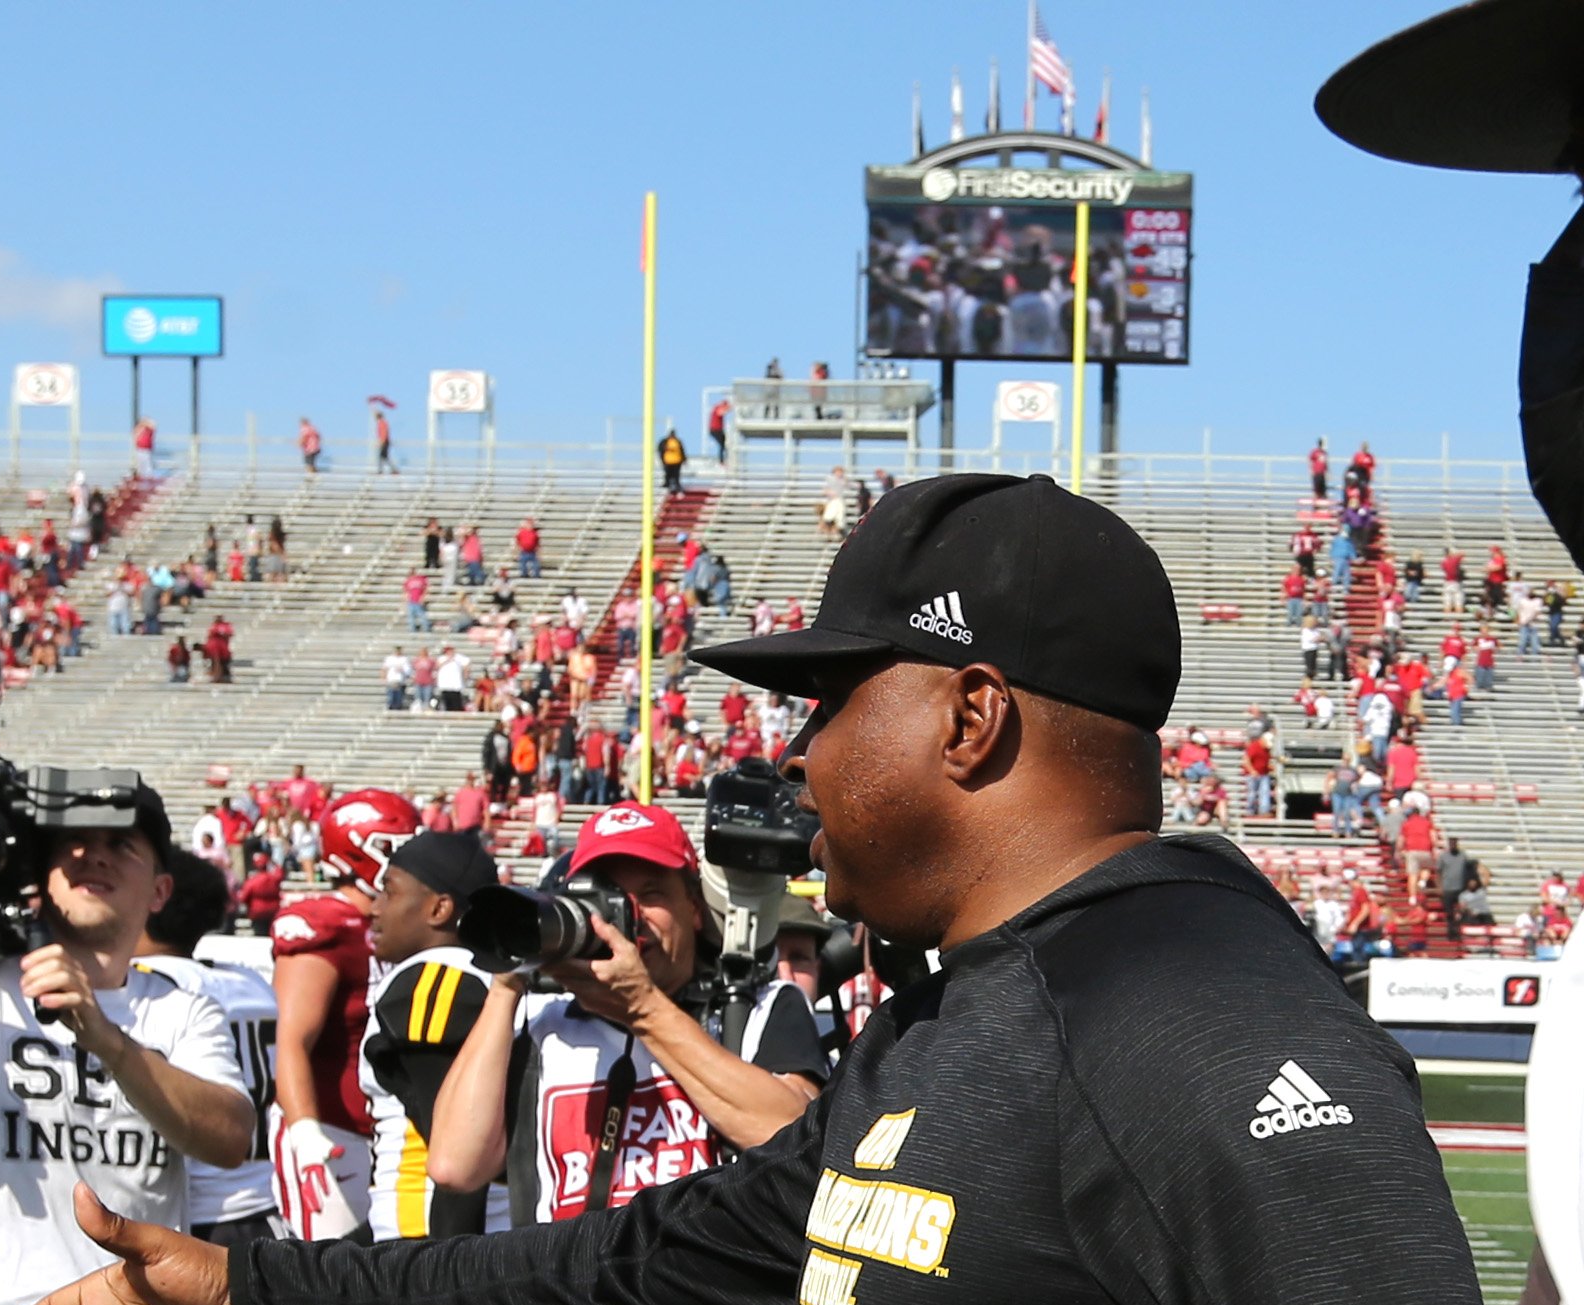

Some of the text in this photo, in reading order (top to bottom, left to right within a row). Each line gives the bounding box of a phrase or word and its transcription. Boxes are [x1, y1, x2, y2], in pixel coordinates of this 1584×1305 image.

[1017, 394, 1040, 413] 36
[909, 613, 973, 645] adidas
[1386, 981, 1496, 1000] Coming Soon
[9, 1034, 112, 1108] SE
[1249, 1101, 1354, 1139] adidas
